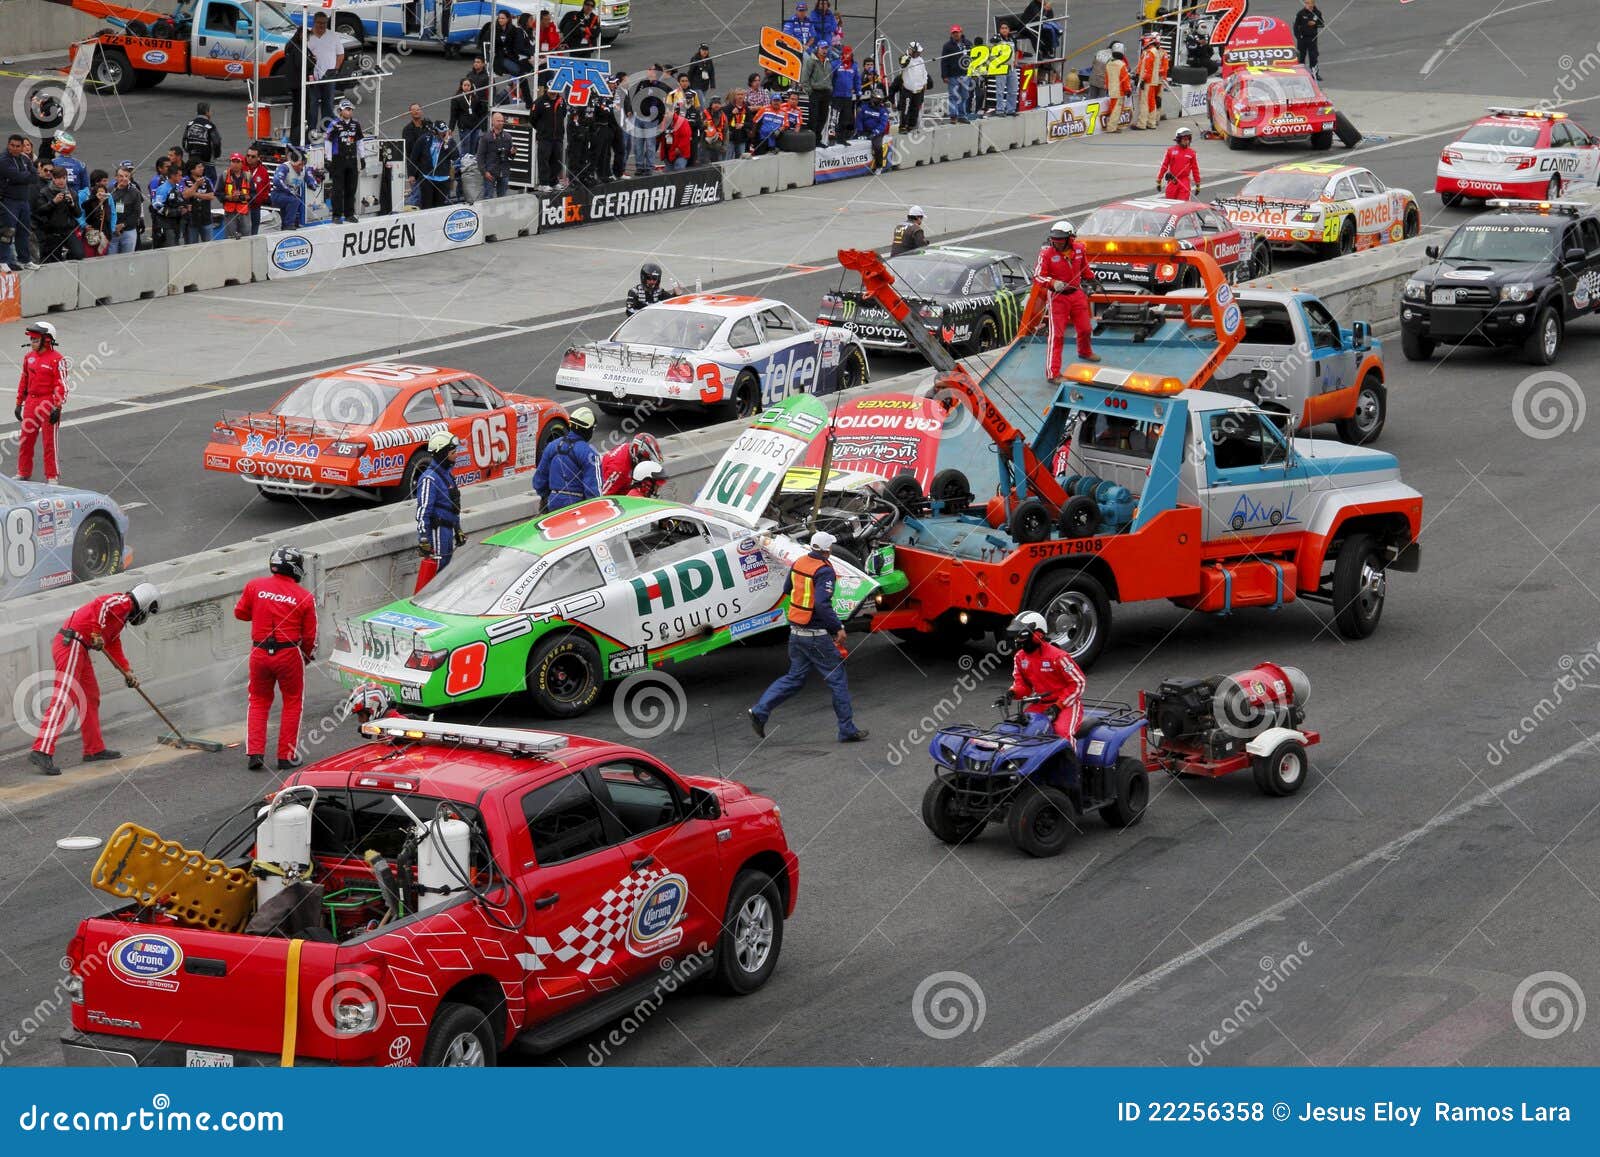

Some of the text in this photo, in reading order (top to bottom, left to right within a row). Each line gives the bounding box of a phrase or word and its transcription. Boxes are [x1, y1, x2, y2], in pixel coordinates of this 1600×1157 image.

[1205, 0, 1247, 45] 7
[967, 44, 1013, 77] 22
[1022, 69, 1034, 91] 7
[569, 79, 592, 106] 5
[1063, 112, 1072, 121] La
[1086, 103, 1100, 135] 7
[1275, 124, 1313, 133] TOYOTA
[1540, 157, 1580, 173] CAMRY
[1468, 181, 1503, 191] TOYOTA
[542, 195, 584, 226] FedEx
[590, 185, 677, 220] GERMAN
[1358, 203, 1391, 227] nextel
[1228, 208, 1288, 226] nextel
[342, 219, 416, 258] RUBÉN
[1323, 216, 1341, 243] 20
[285, 248, 310, 258] TELMEX
[859, 325, 908, 338] TOYOTA
[602, 373, 645, 384] SAMSUNG
[696, 362, 725, 404] 3
[761, 348, 823, 405] telcel
[903, 416, 941, 431] CAR
[263, 435, 320, 459] picsa
[338, 444, 353, 455] 05
[368, 427, 412, 451] HOME
[471, 414, 510, 468] 05
[735, 435, 796, 466] Seguros
[258, 461, 313, 479] TOYOTA
[373, 453, 405, 473] picsa
[455, 470, 481, 486] INSA
[705, 460, 777, 513] HDI
[1029, 538, 1103, 559] 55717908
[515, 560, 549, 596] EXCELSIOR
[629, 549, 736, 617] HDI
[257, 590, 297, 605] OFICIAL
[641, 598, 741, 642] Seguros
[731, 622, 751, 634] Auto
[446, 641, 488, 696] 8
[539, 642, 573, 690] GOODYEAR
[609, 652, 645, 673] GMI
[401, 686, 421, 701] GMI
[644, 904, 671, 926] Corona
[127, 950, 164, 968] Corona
[144, 943, 169, 955] NASCAR
[87, 1015, 142, 1029] TUNDRA
[384, 1056, 412, 1067] OYOTA
